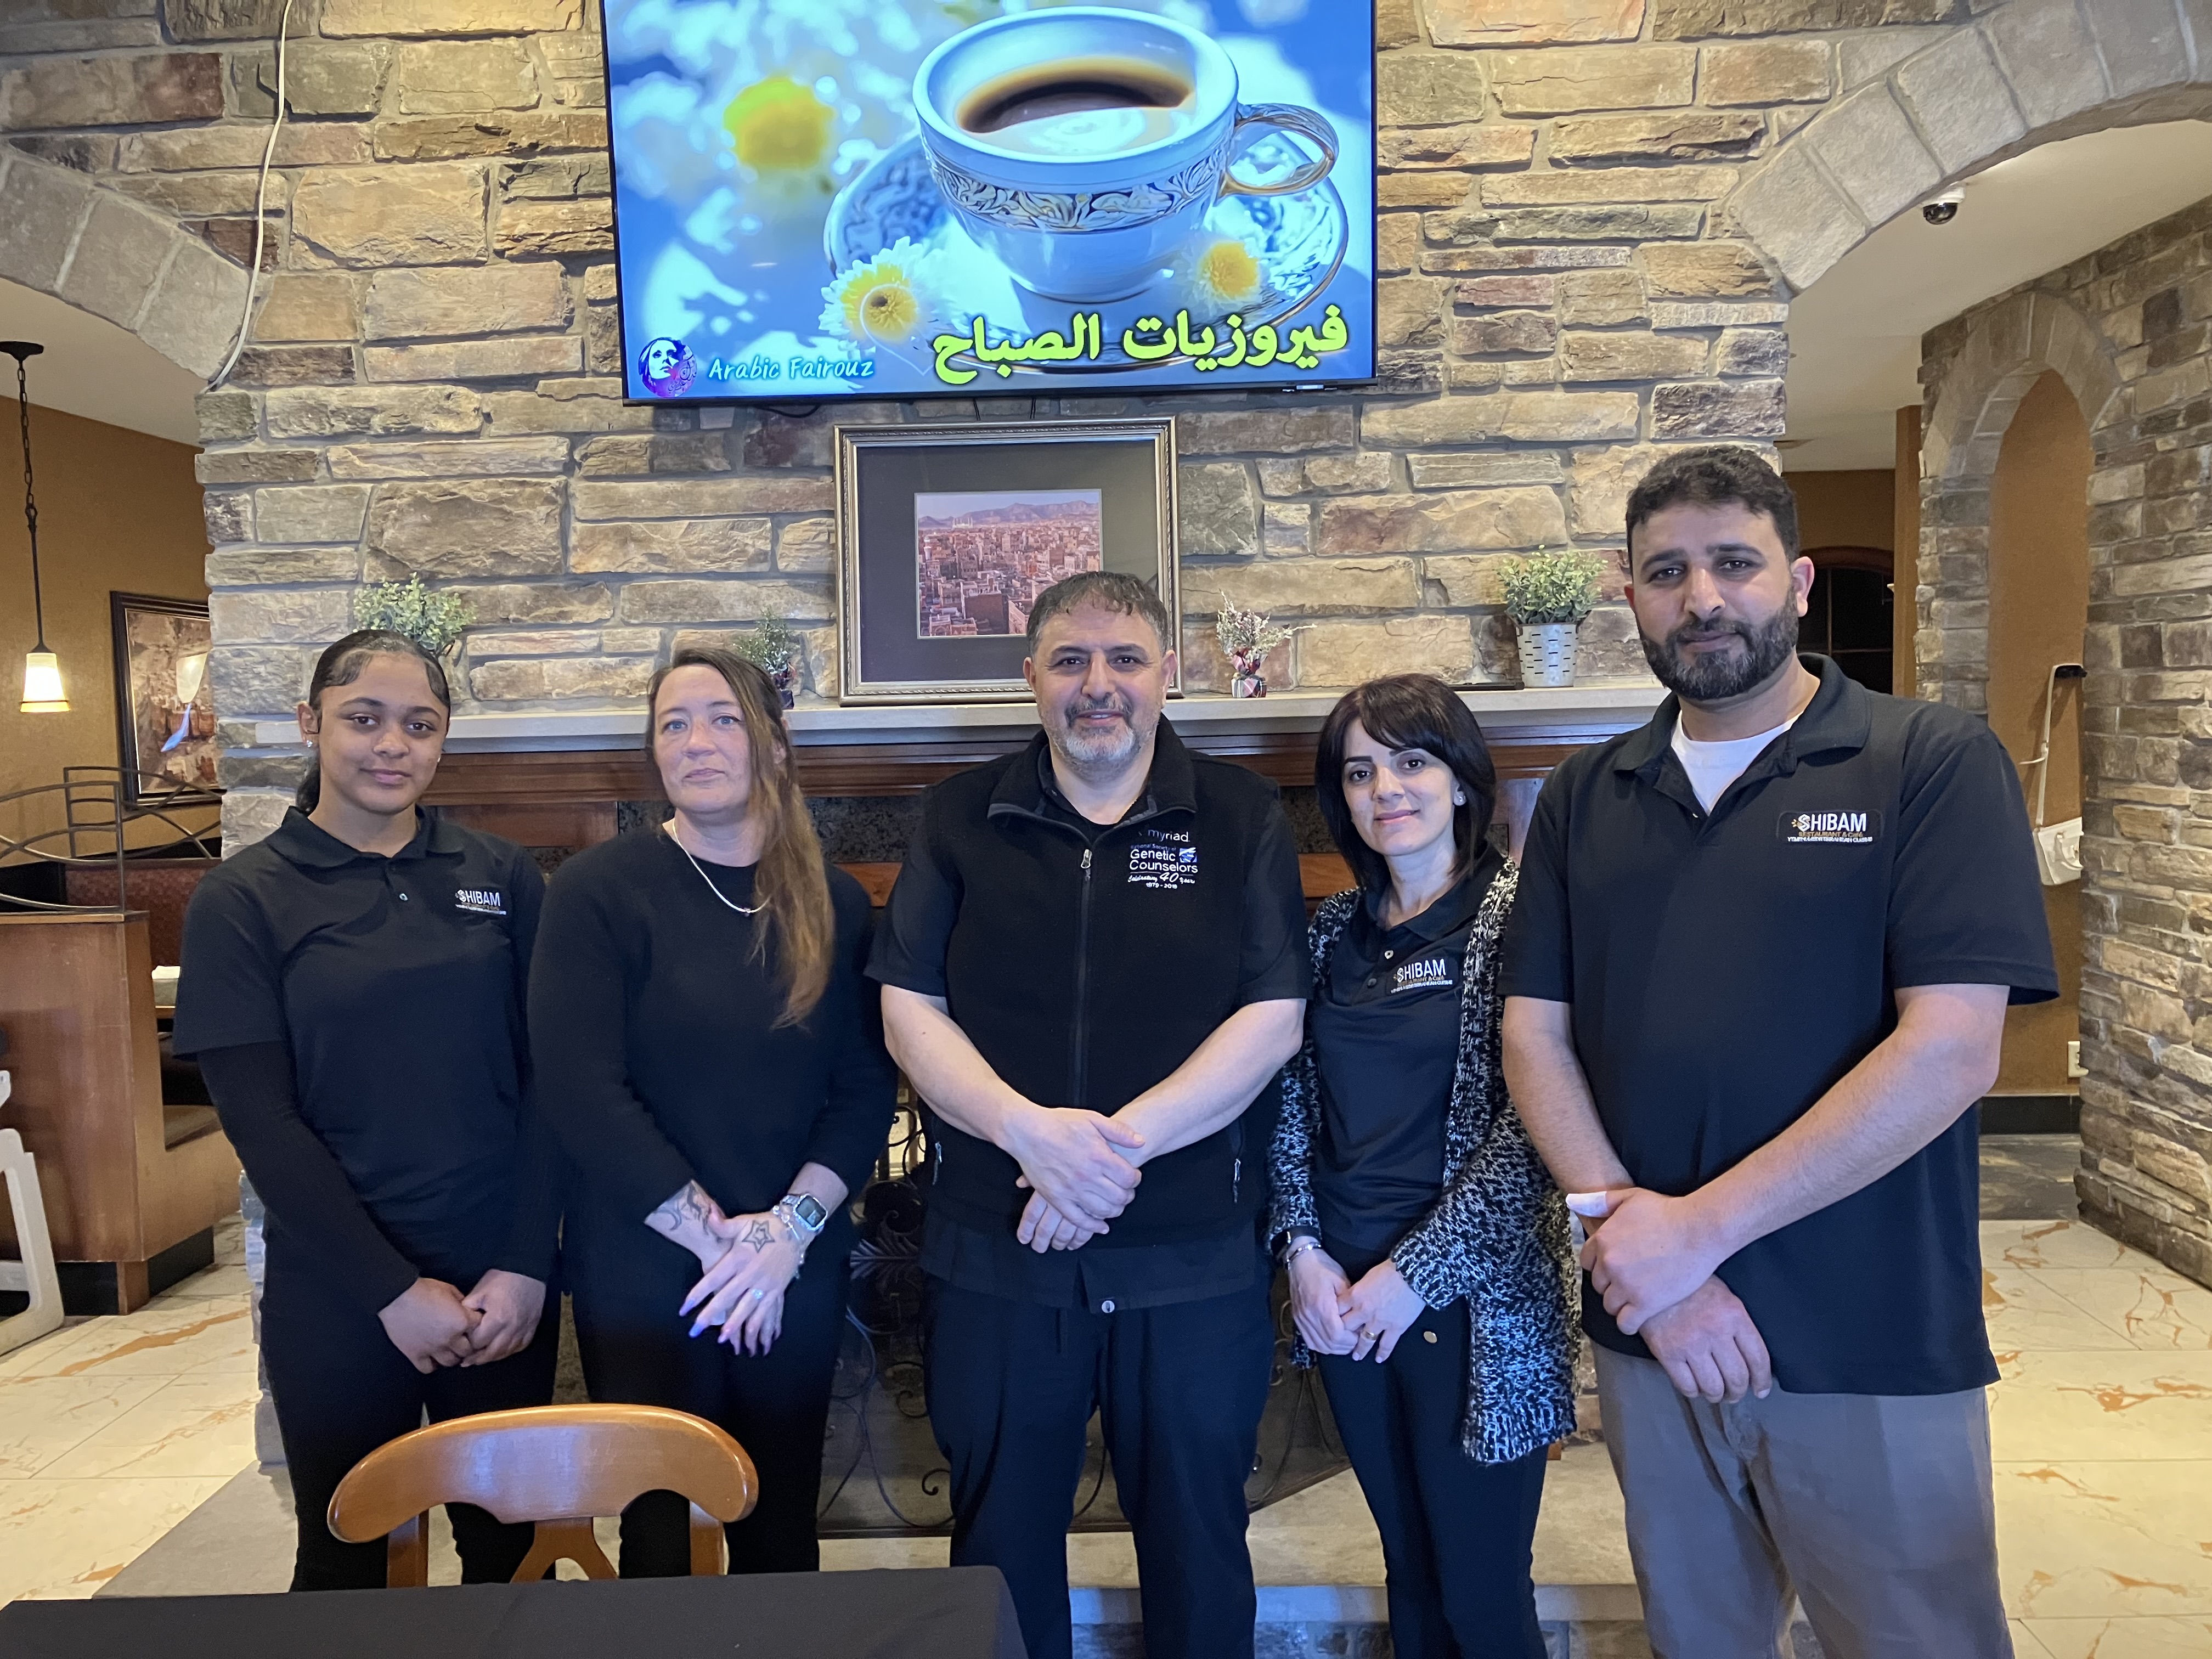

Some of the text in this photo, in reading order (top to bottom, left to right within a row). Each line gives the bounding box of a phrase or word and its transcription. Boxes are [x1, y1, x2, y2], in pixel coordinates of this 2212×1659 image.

[933, 304, 1348, 385] فيروزيات الصباح
[708, 357, 779, 380] Arabic
[790, 357, 874, 378] Fairouz
[1797, 812, 1866, 832] SHIBAM
[1148, 829, 1189, 842] myriad
[1130, 849, 1176, 861] Genetic
[1129, 859, 1198, 873] Counselors
[1159, 872, 1179, 883] 40
[457, 889, 501, 907] SHIBAM
[1397, 958, 1446, 983] SHIBAM
